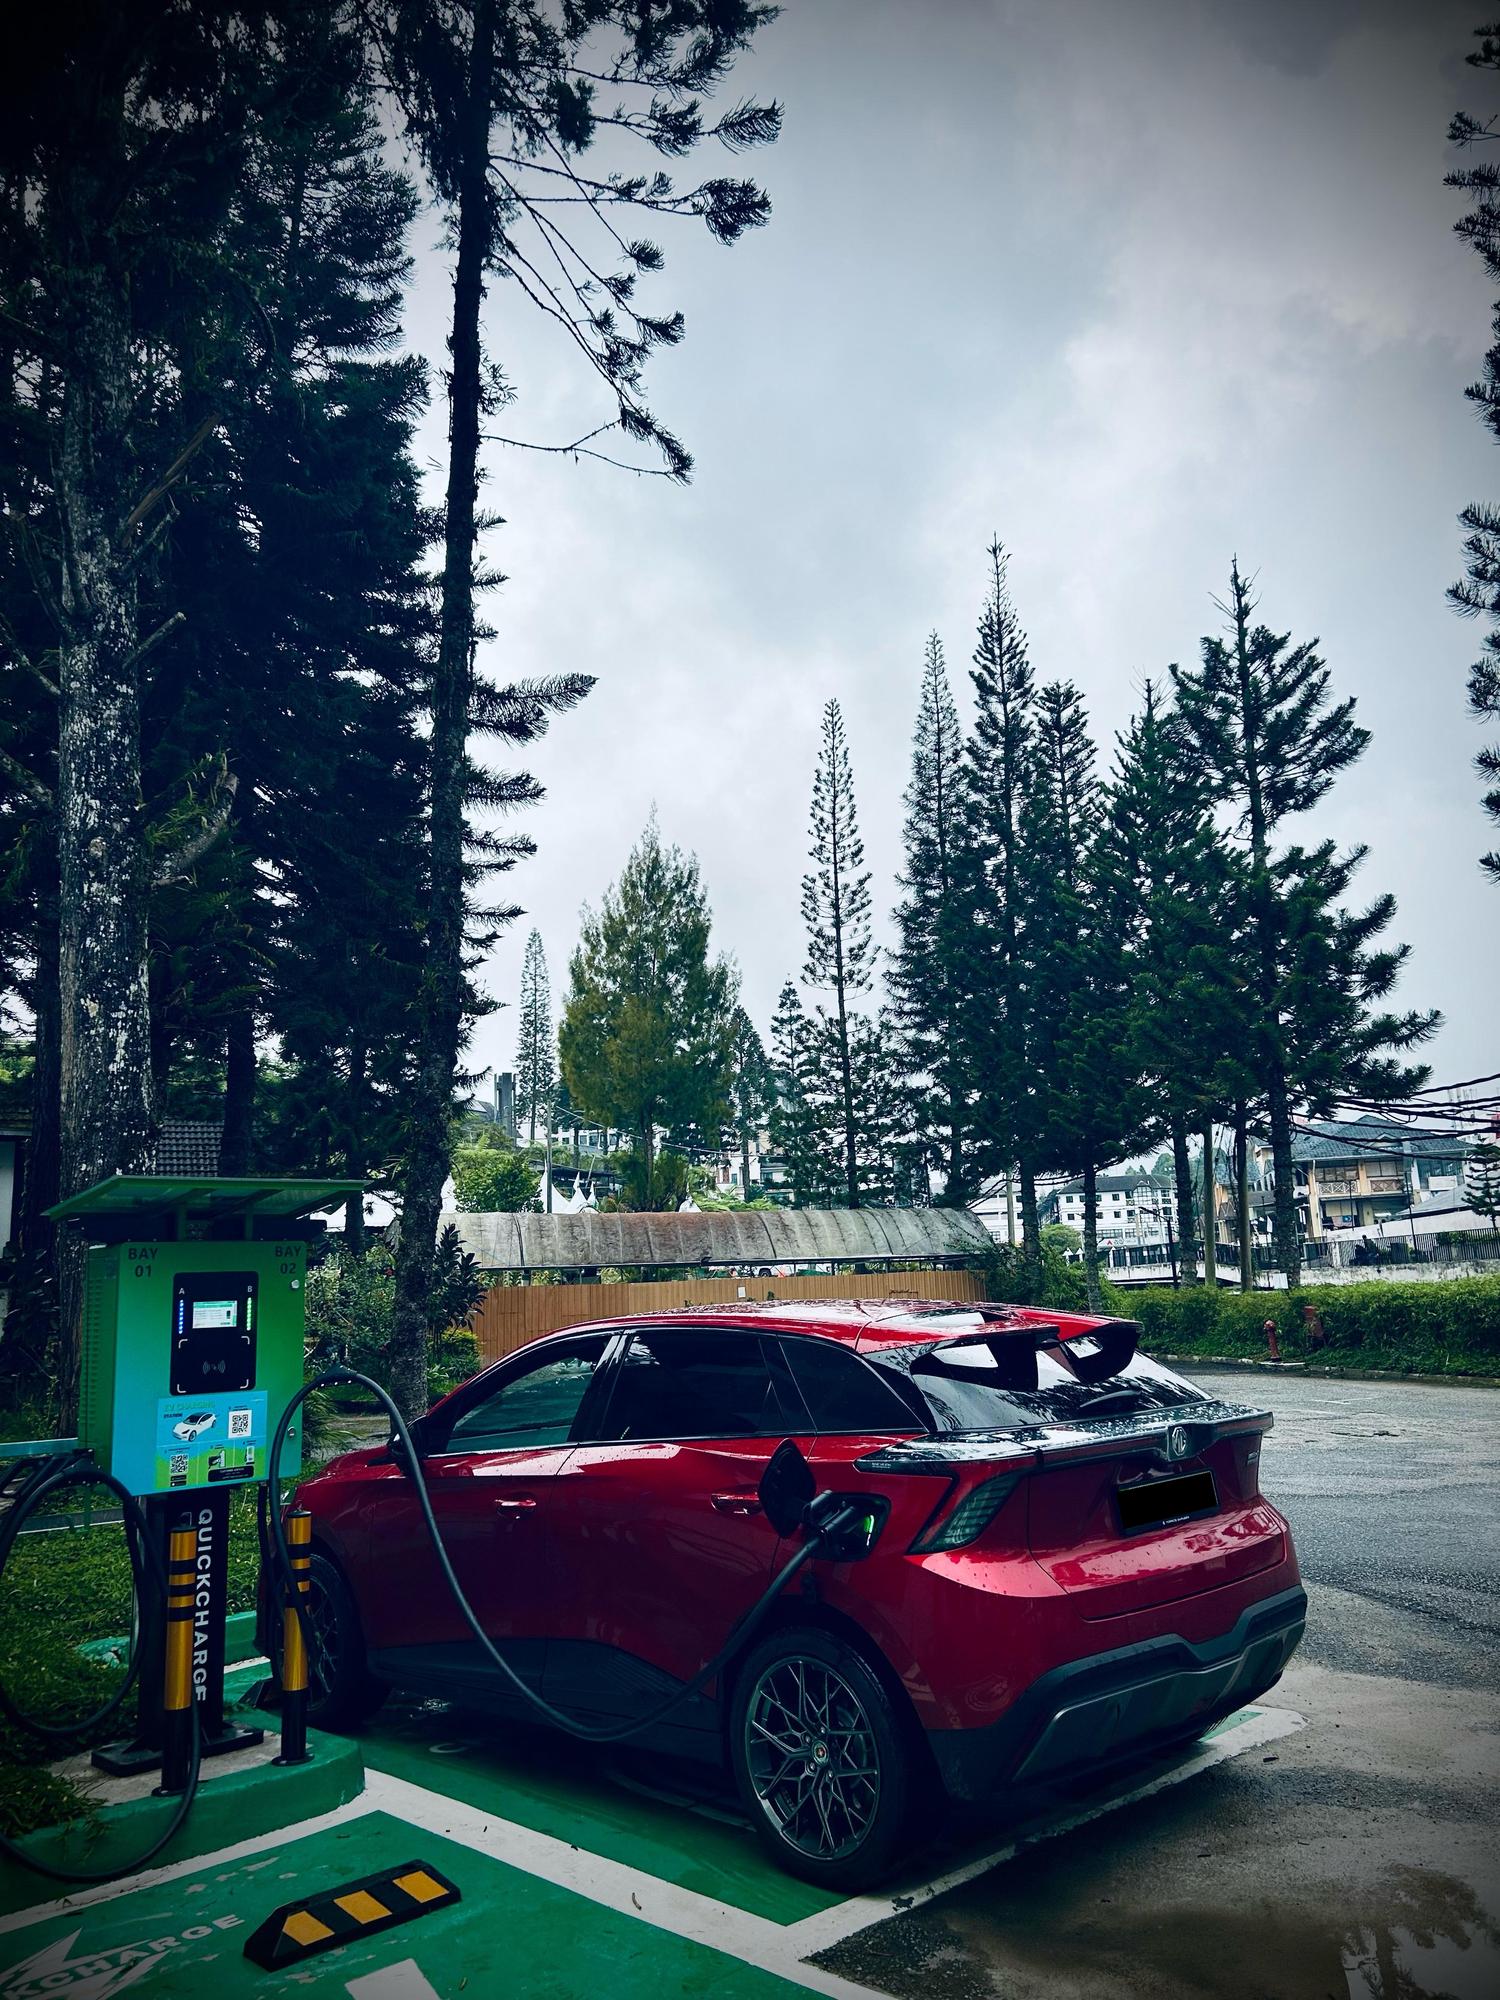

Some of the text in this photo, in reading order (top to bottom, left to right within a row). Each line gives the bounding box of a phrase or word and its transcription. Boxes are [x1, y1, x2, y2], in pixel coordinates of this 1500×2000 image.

[128, 1248, 158, 1260] BAY
[275, 1246, 301, 1257] BAY
[135, 1264, 152, 1277] 01
[280, 1263, 297, 1274] 02
[178, 1287, 185, 1295] A
[247, 1285, 253, 1293] B
[193, 1508, 213, 1701] QUICKCHARGE
